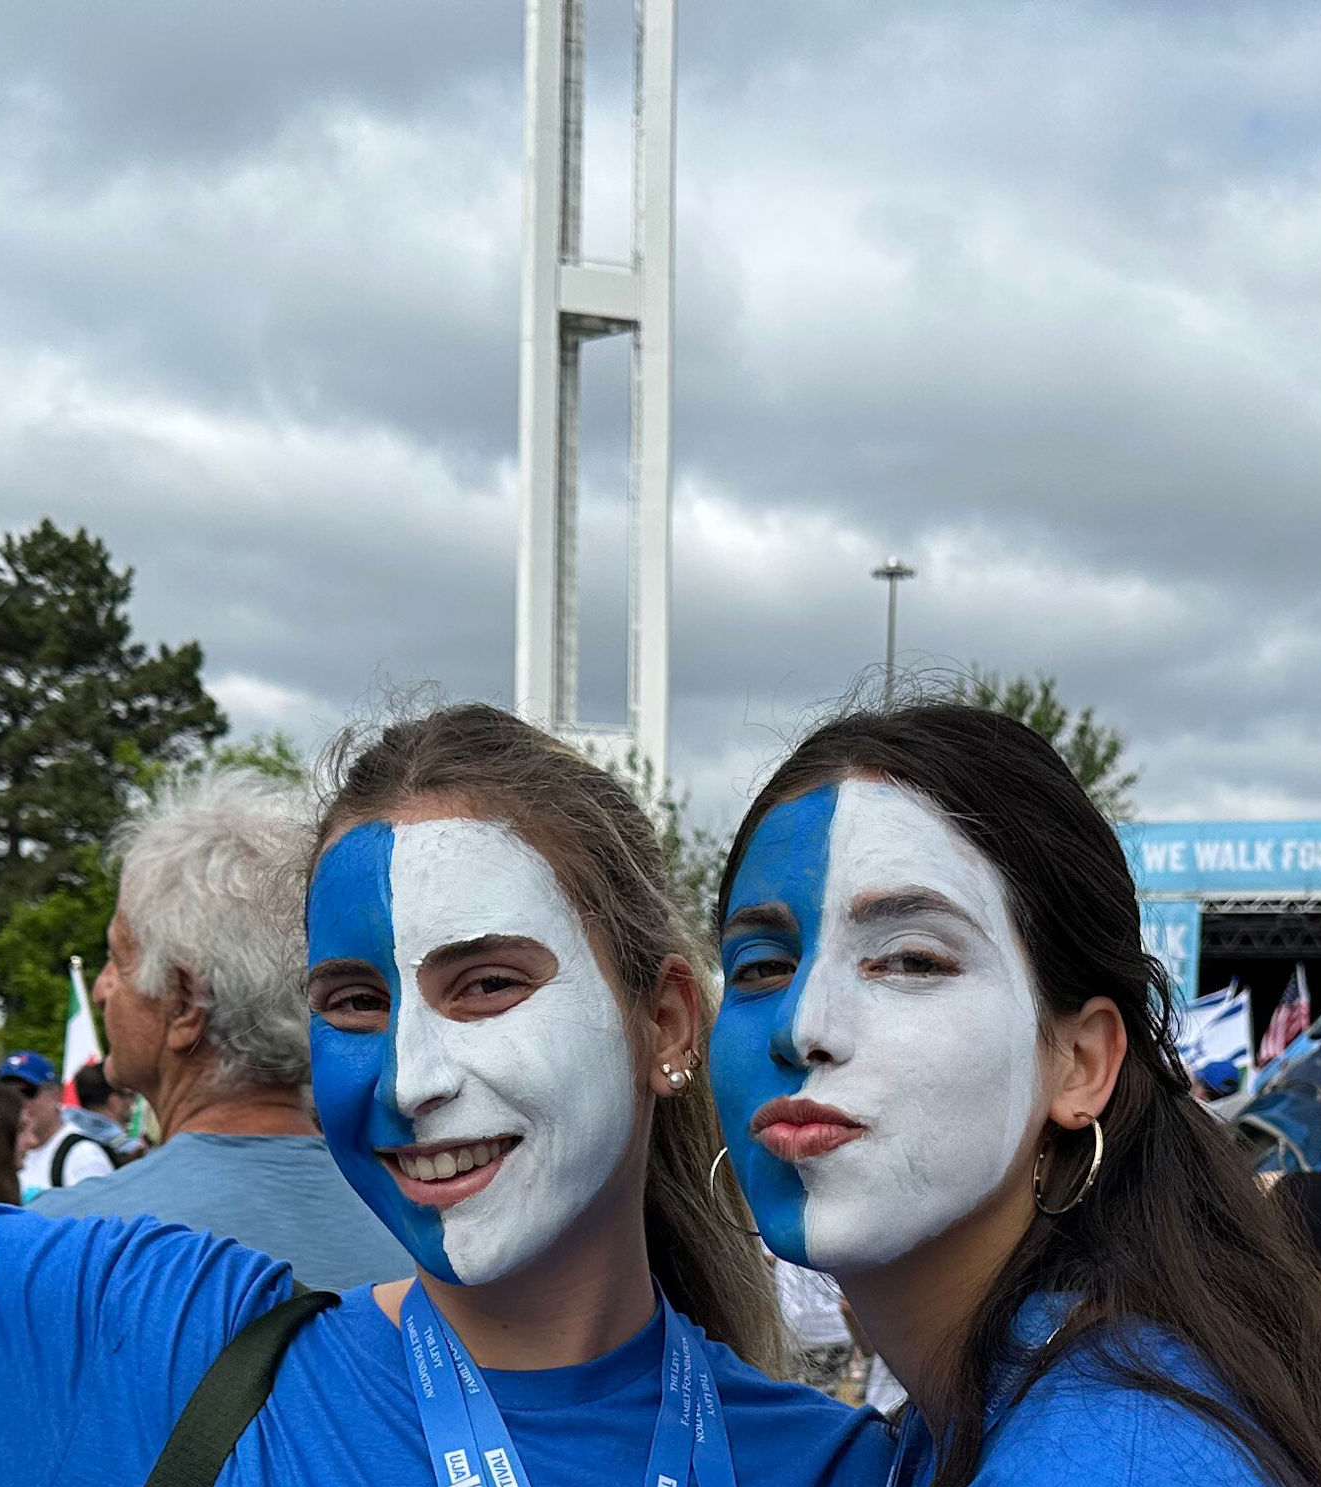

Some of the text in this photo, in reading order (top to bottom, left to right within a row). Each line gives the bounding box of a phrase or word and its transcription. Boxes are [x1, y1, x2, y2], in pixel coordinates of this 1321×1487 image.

[1142, 840, 1187, 872] WE
[1194, 839, 1275, 872] WALK
[406, 1315, 436, 1399] FAMILY FOUNDATION
[424, 1325, 444, 1369] THE LEVY
[449, 1453, 466, 1480] UJA
